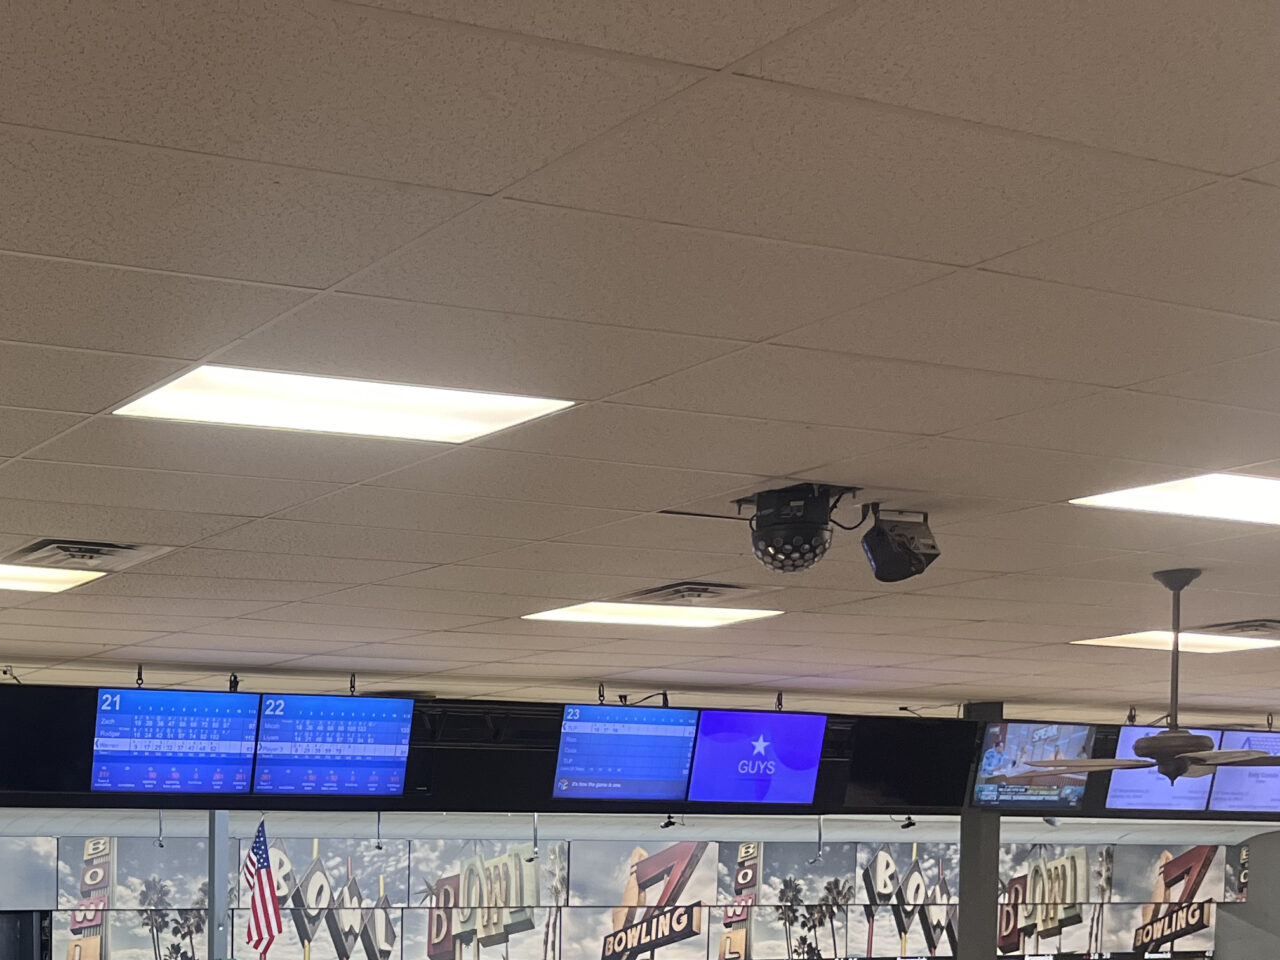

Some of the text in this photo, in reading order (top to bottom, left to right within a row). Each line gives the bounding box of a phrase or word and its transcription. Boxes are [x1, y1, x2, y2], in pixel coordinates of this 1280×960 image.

[101, 694, 120, 710] 21
[265, 699, 285, 715] 22
[567, 708, 580, 719] 23
[738, 760, 775, 775] GUYS
[726, 843, 757, 959] BOWL
[604, 906, 689, 957] BOWLING
[1135, 902, 1201, 947] BOWLING
